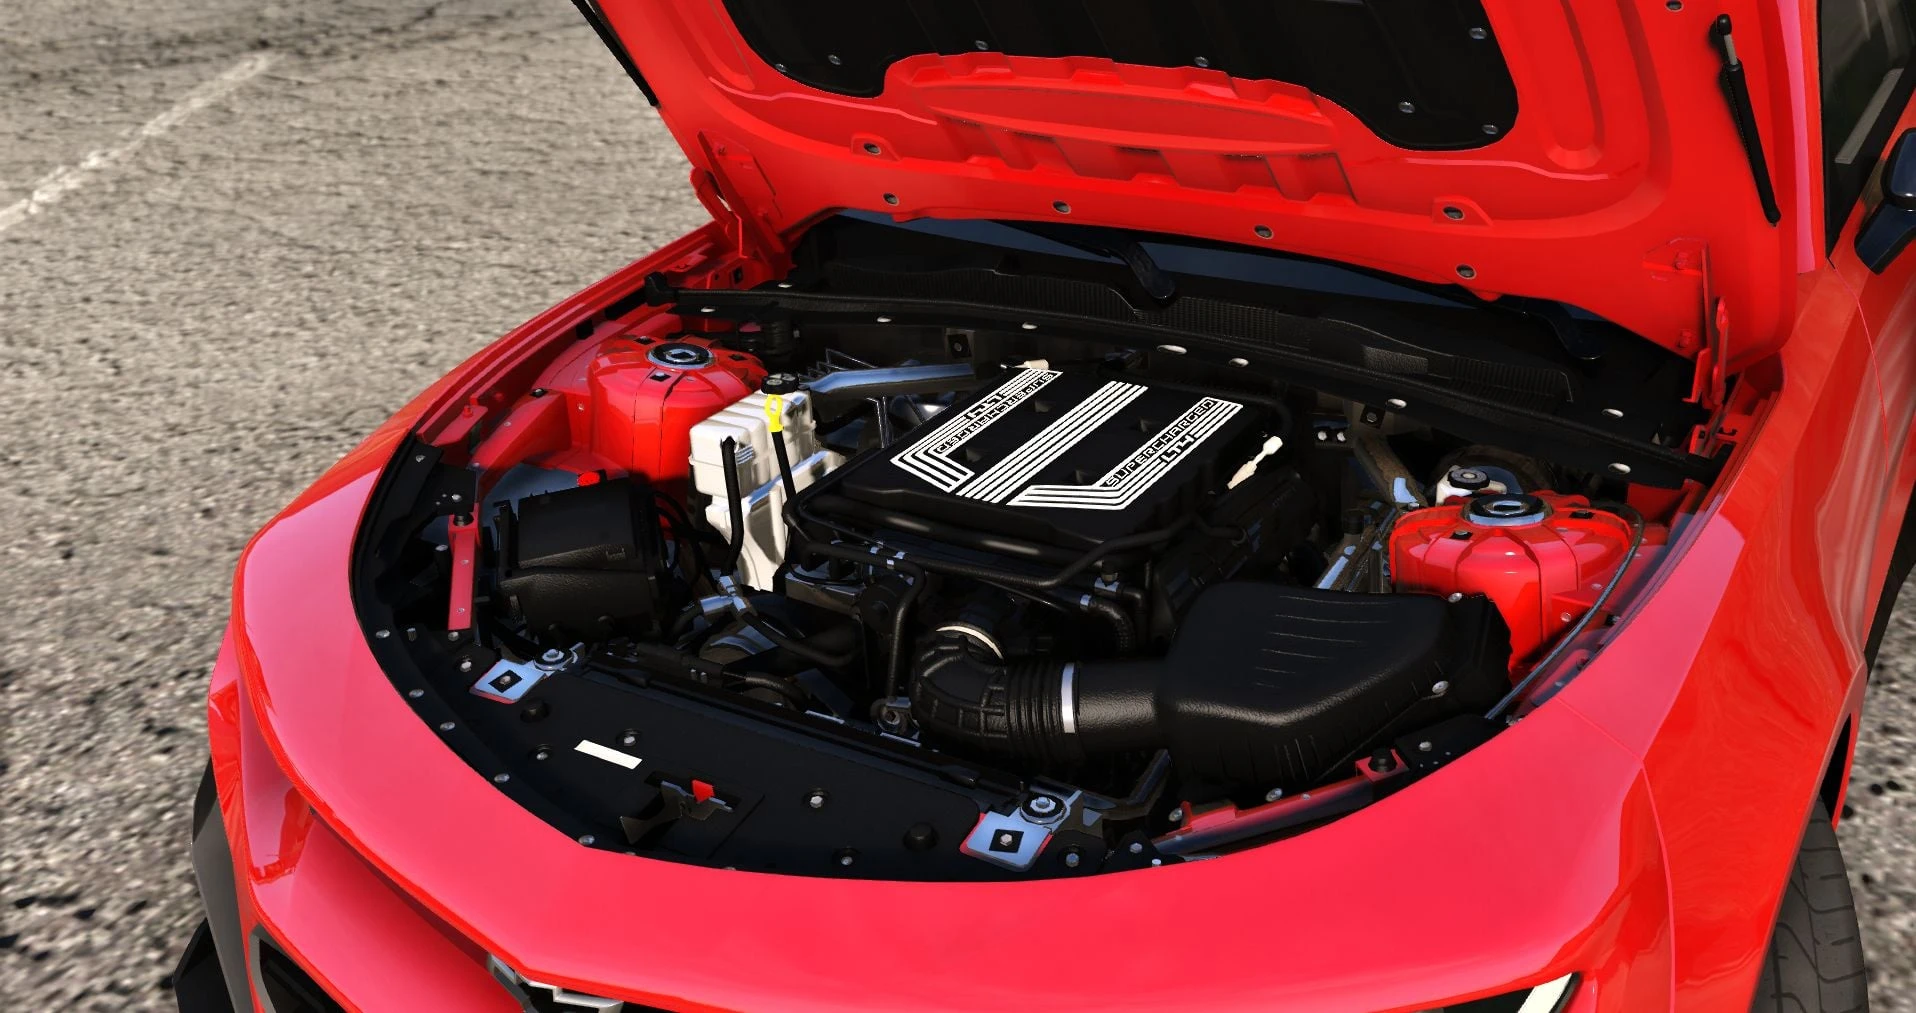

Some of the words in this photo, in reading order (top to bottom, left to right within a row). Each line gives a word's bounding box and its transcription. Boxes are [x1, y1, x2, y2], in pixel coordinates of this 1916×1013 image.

[937, 372, 1054, 453] SUPERCHARGED
[967, 393, 1002, 418] LT4
[1106, 399, 1215, 487] SUPERCHARGED
[1161, 433, 1195, 464] LT4
